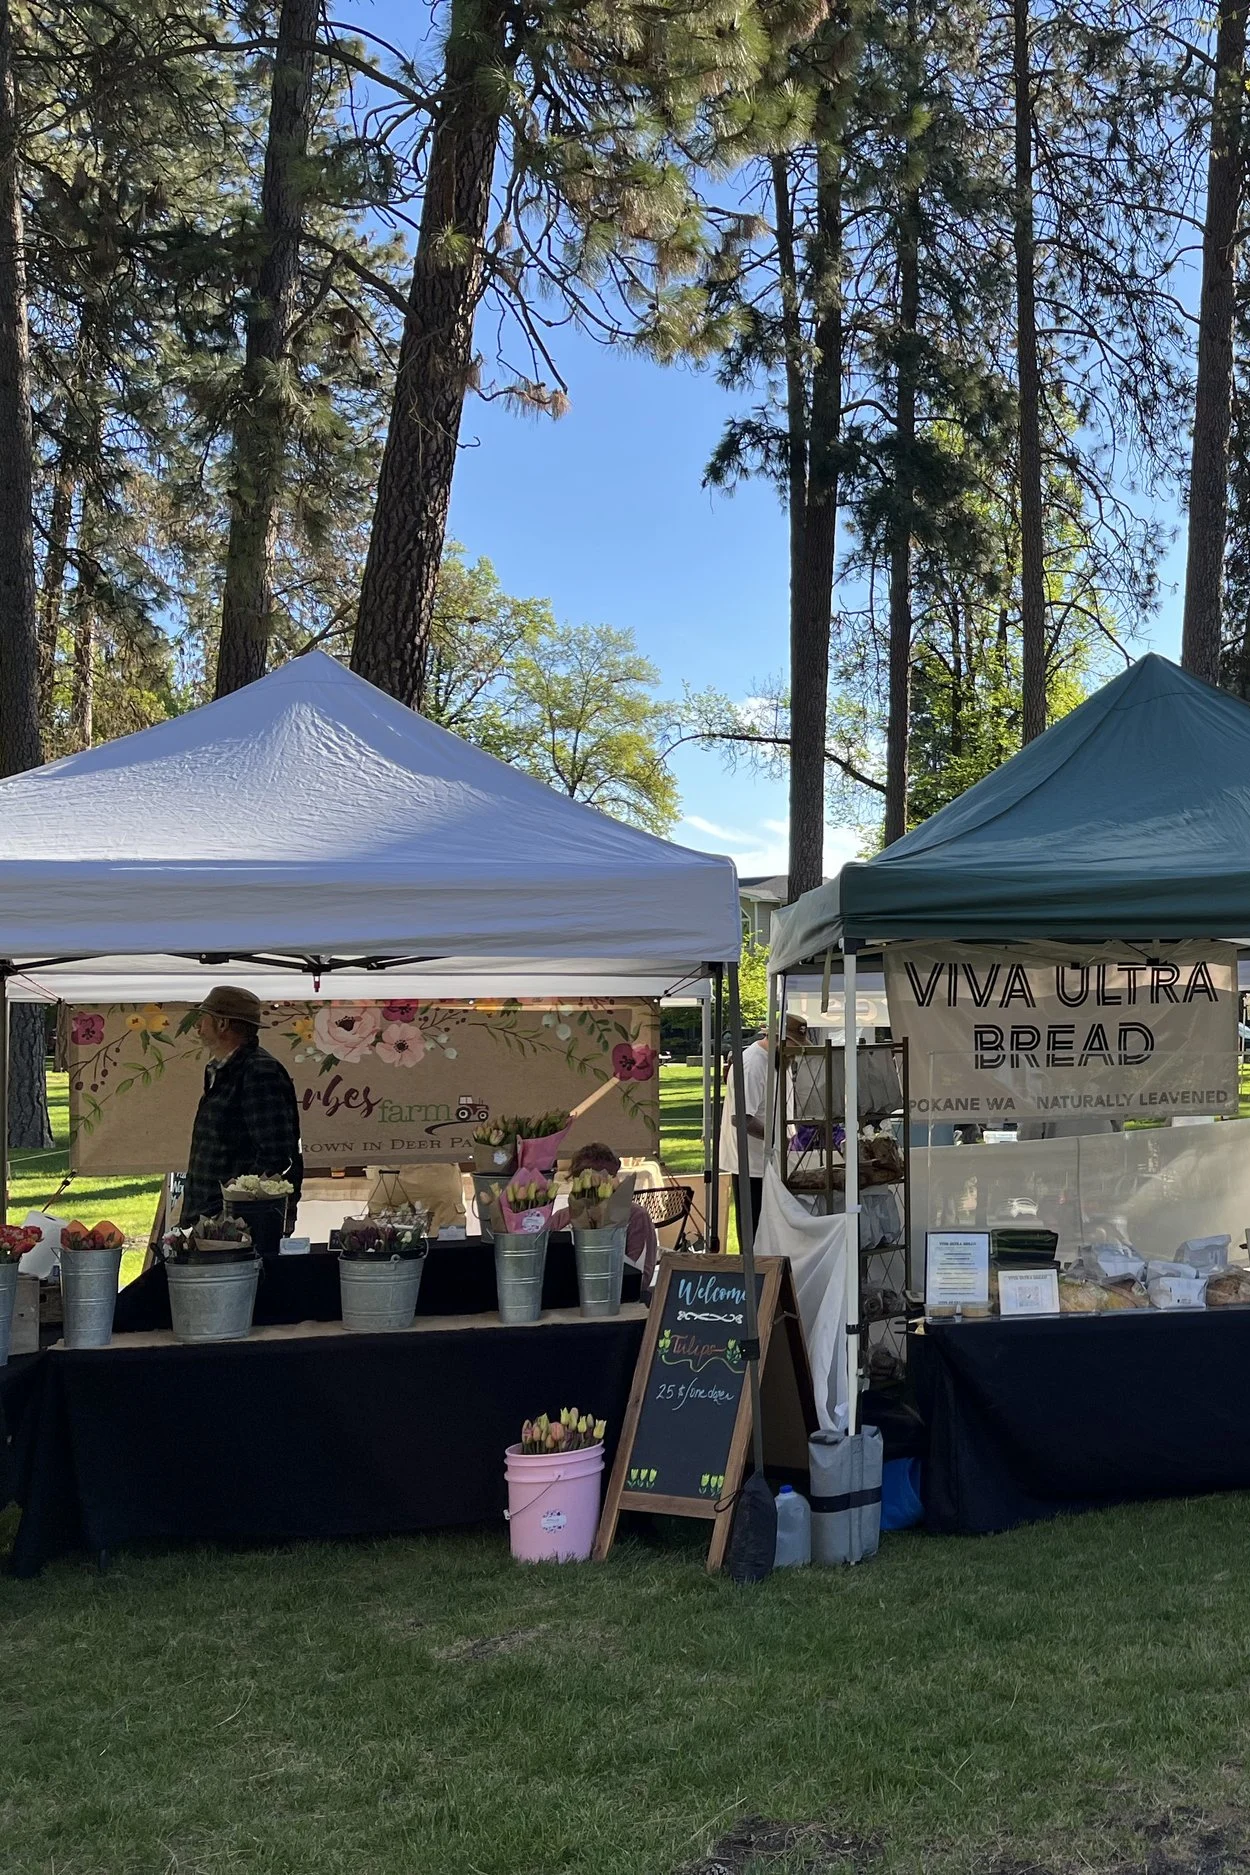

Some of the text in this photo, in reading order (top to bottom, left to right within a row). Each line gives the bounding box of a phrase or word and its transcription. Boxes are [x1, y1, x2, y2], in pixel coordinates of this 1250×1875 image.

[904, 961, 1036, 1008] VIVA
[1056, 961, 1219, 1008] ULTRA
[974, 1022, 1154, 1070] BREAD
[378, 1099, 453, 1123] farm
[909, 1090, 1228, 1113] POKANE WA NATURALLY LEAVENED
[301, 1142, 355, 1152] ROWN
[363, 1141, 386, 1151] IN
[678, 1275, 746, 1305] Welcom
[671, 1334, 724, 1367] Tulips
